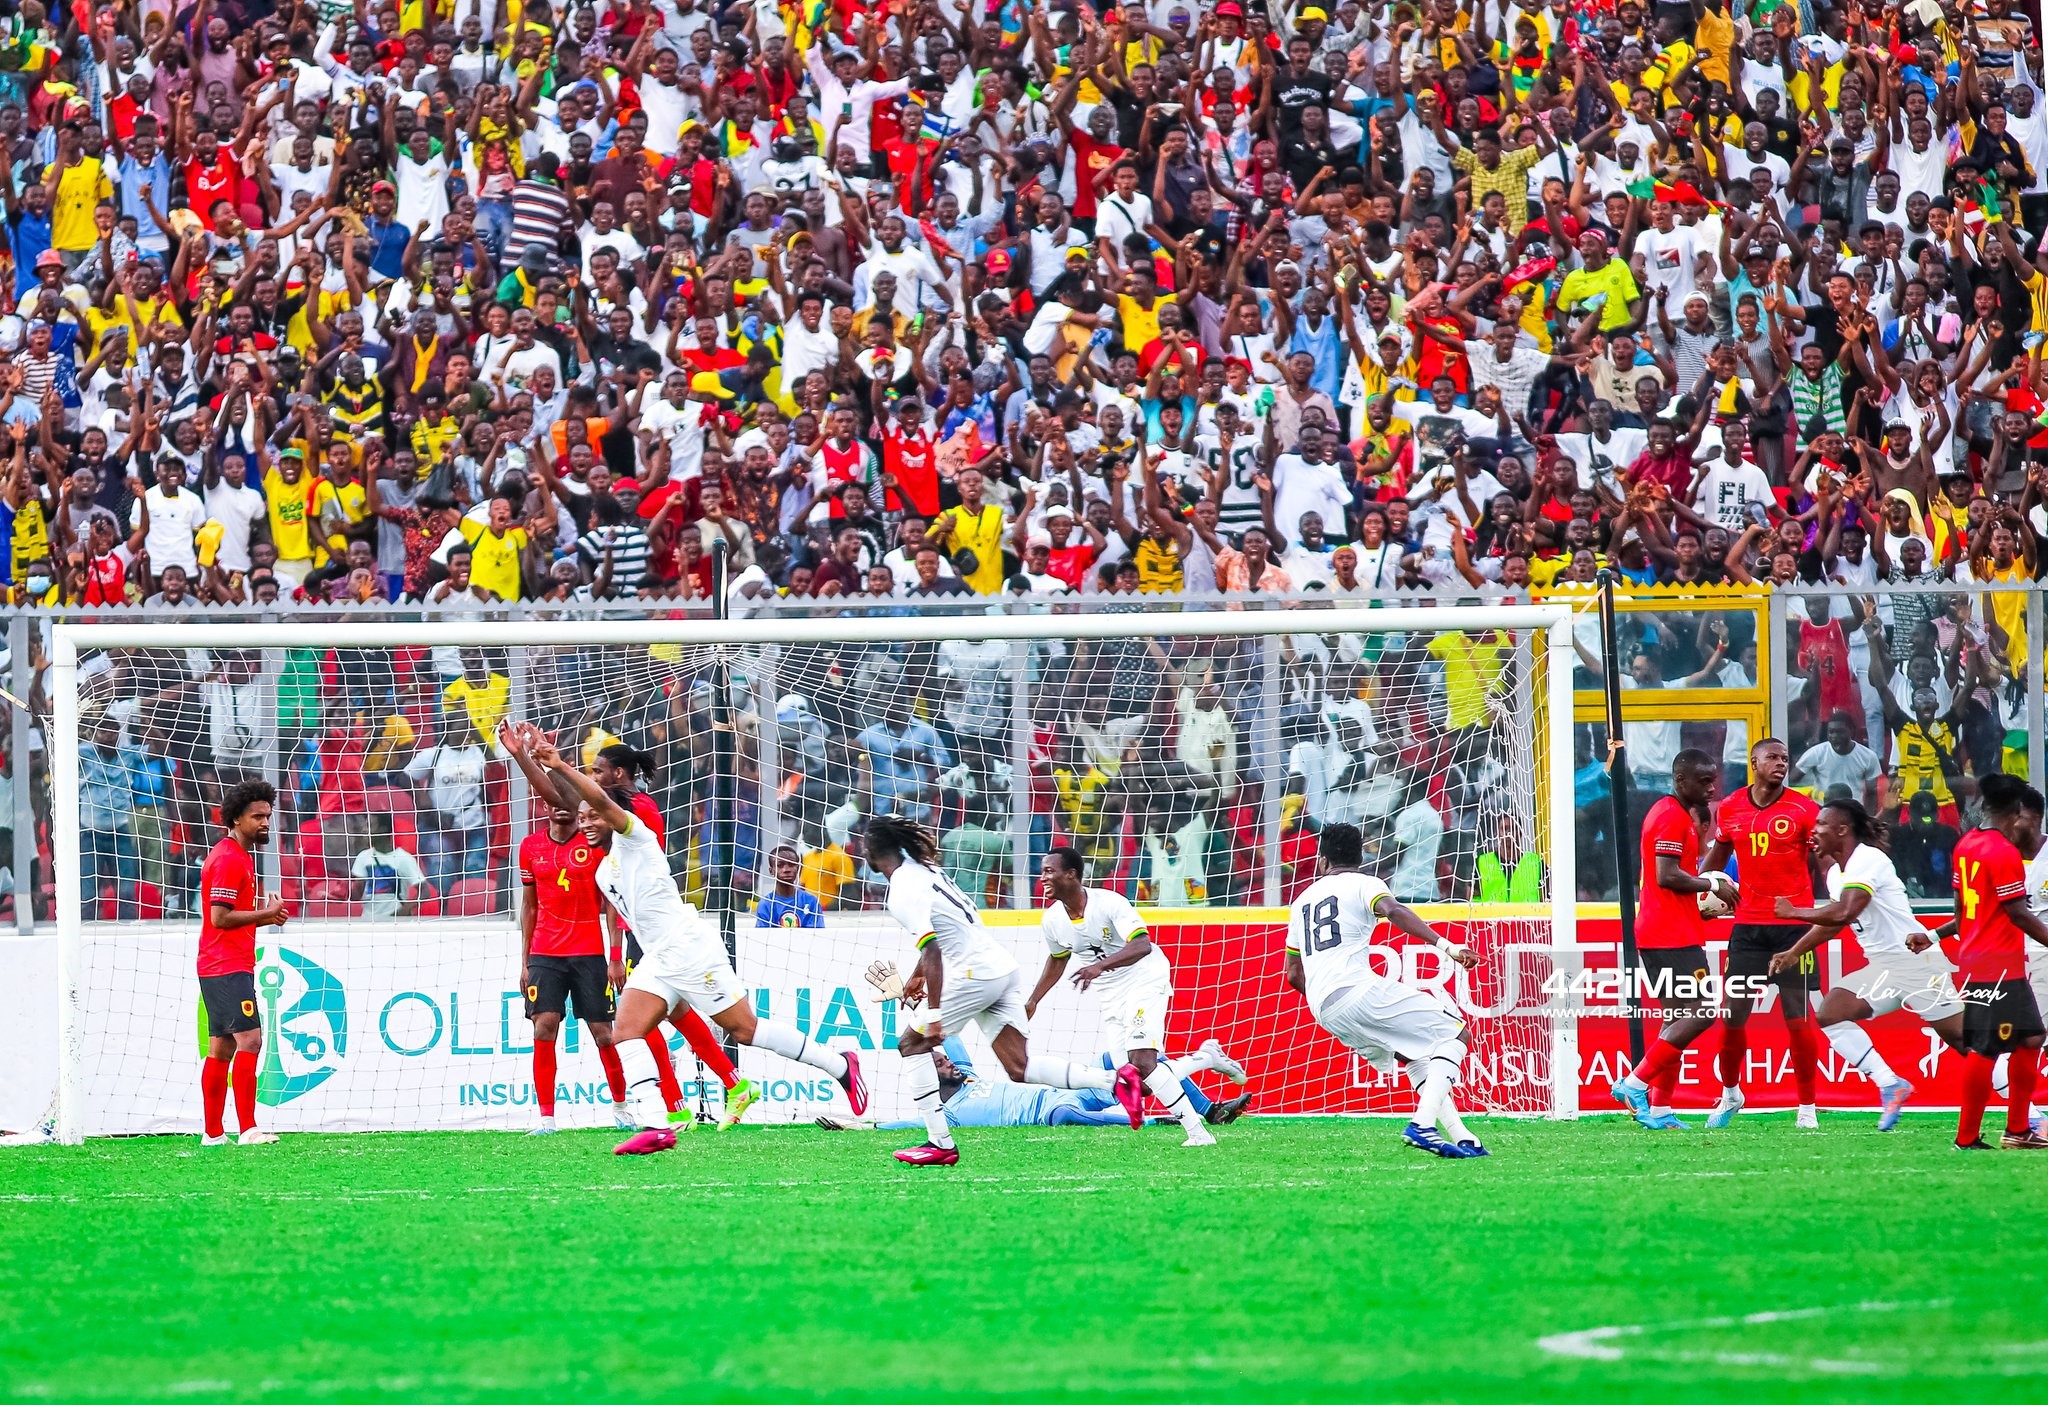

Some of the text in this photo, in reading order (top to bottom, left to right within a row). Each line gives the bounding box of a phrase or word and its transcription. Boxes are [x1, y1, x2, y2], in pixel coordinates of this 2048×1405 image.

[1748, 832, 1769, 857] 19
[557, 868, 570, 892] 4
[1958, 857, 1981, 920] 14
[1302, 895, 1342, 957] 18
[1800, 950, 1815, 975] 19
[460, 1079, 834, 1106] INSUANC PEIONS
